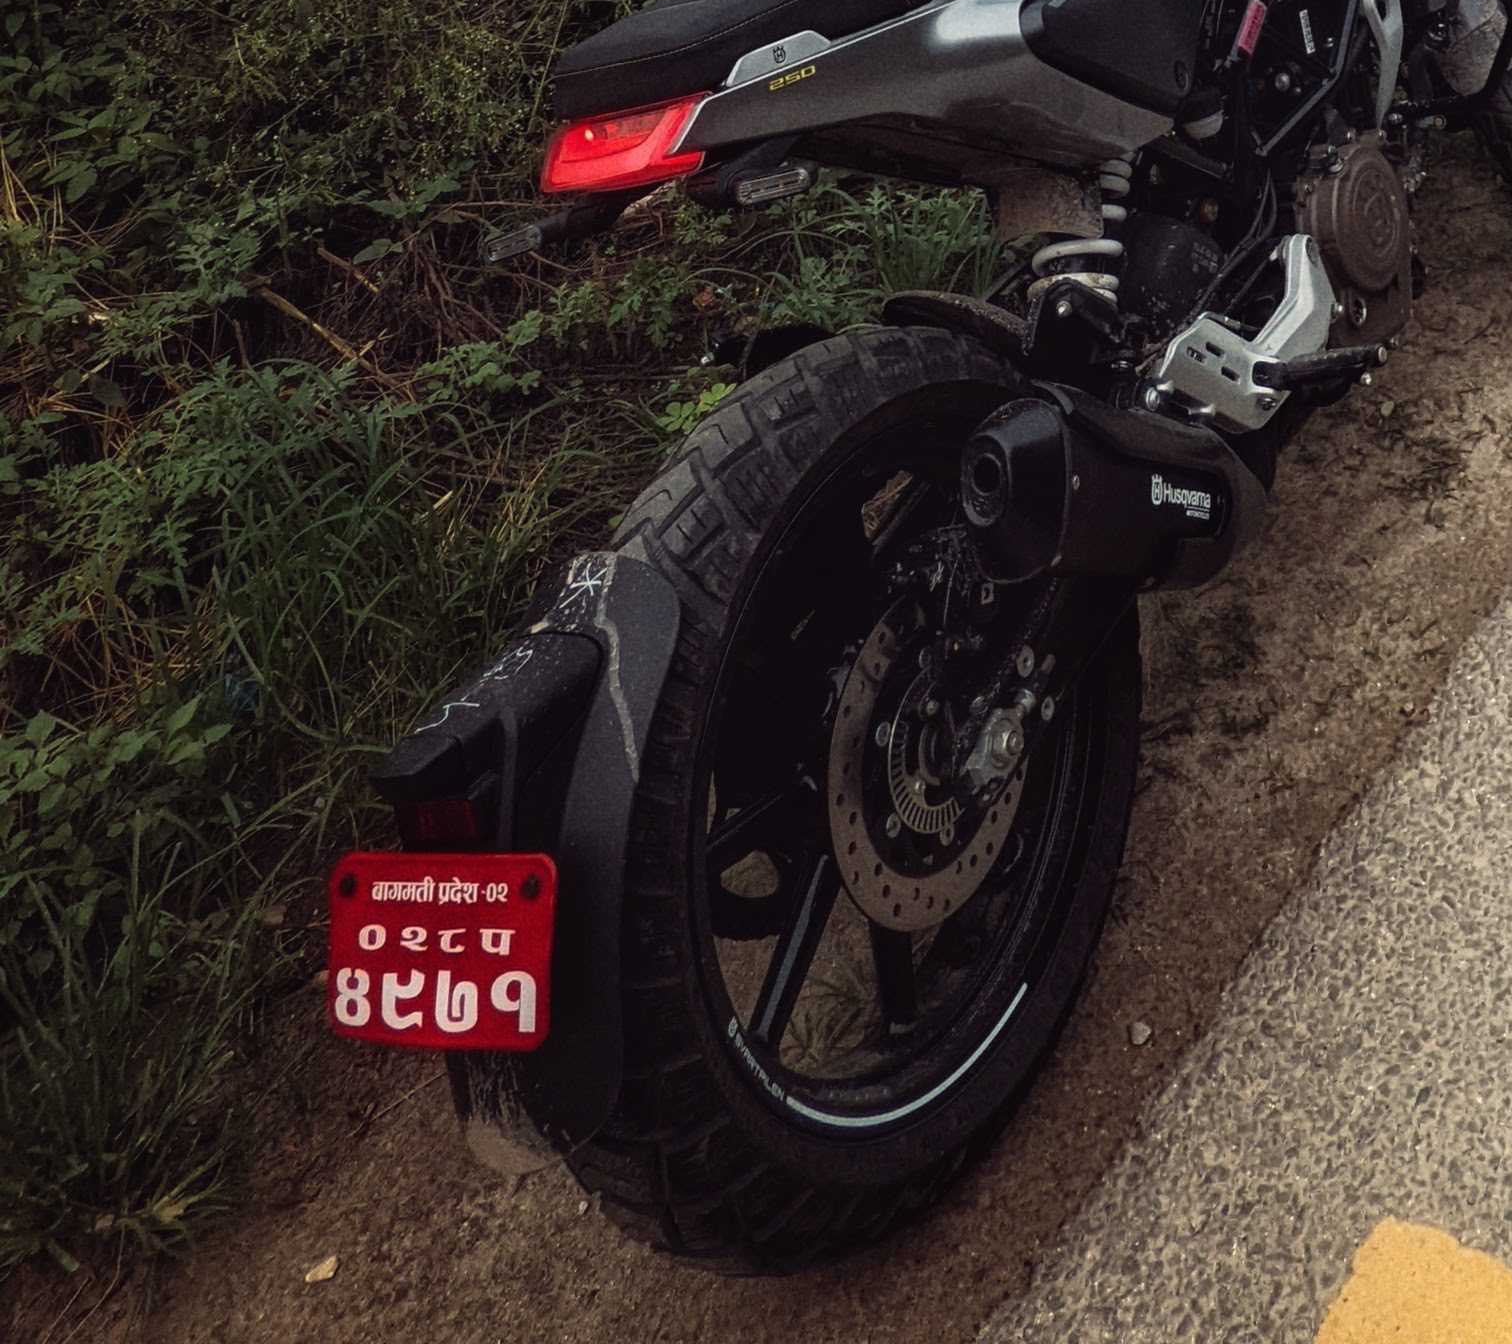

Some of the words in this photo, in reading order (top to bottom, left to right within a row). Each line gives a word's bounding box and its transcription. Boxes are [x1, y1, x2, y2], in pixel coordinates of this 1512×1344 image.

[769, 65, 816, 91] 250
[1163, 482, 1211, 509] Husqvarna
[438, 876, 480, 905] प्रदेश
